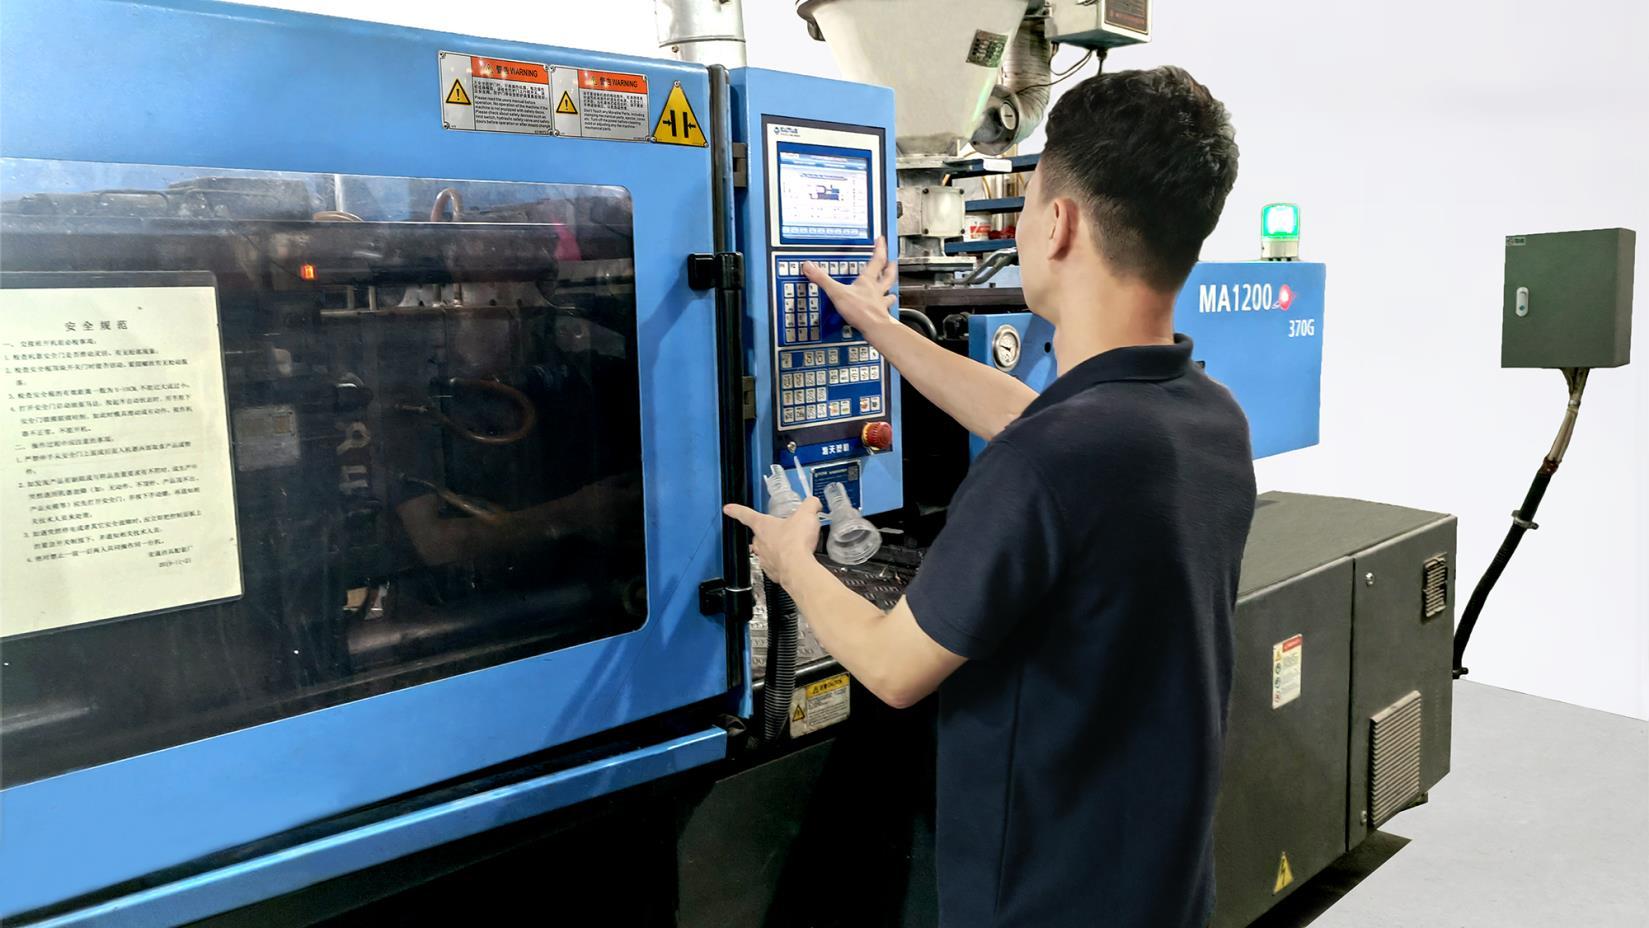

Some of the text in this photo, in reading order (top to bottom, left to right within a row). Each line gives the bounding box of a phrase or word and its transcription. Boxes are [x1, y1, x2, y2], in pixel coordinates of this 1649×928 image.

[510, 67, 538, 78] WARNING
[612, 79, 638, 88] WARNING
[1199, 283, 1273, 313] MA1200
[64, 320, 128, 332] 安全规范
[1287, 319, 1315, 338] 370G
